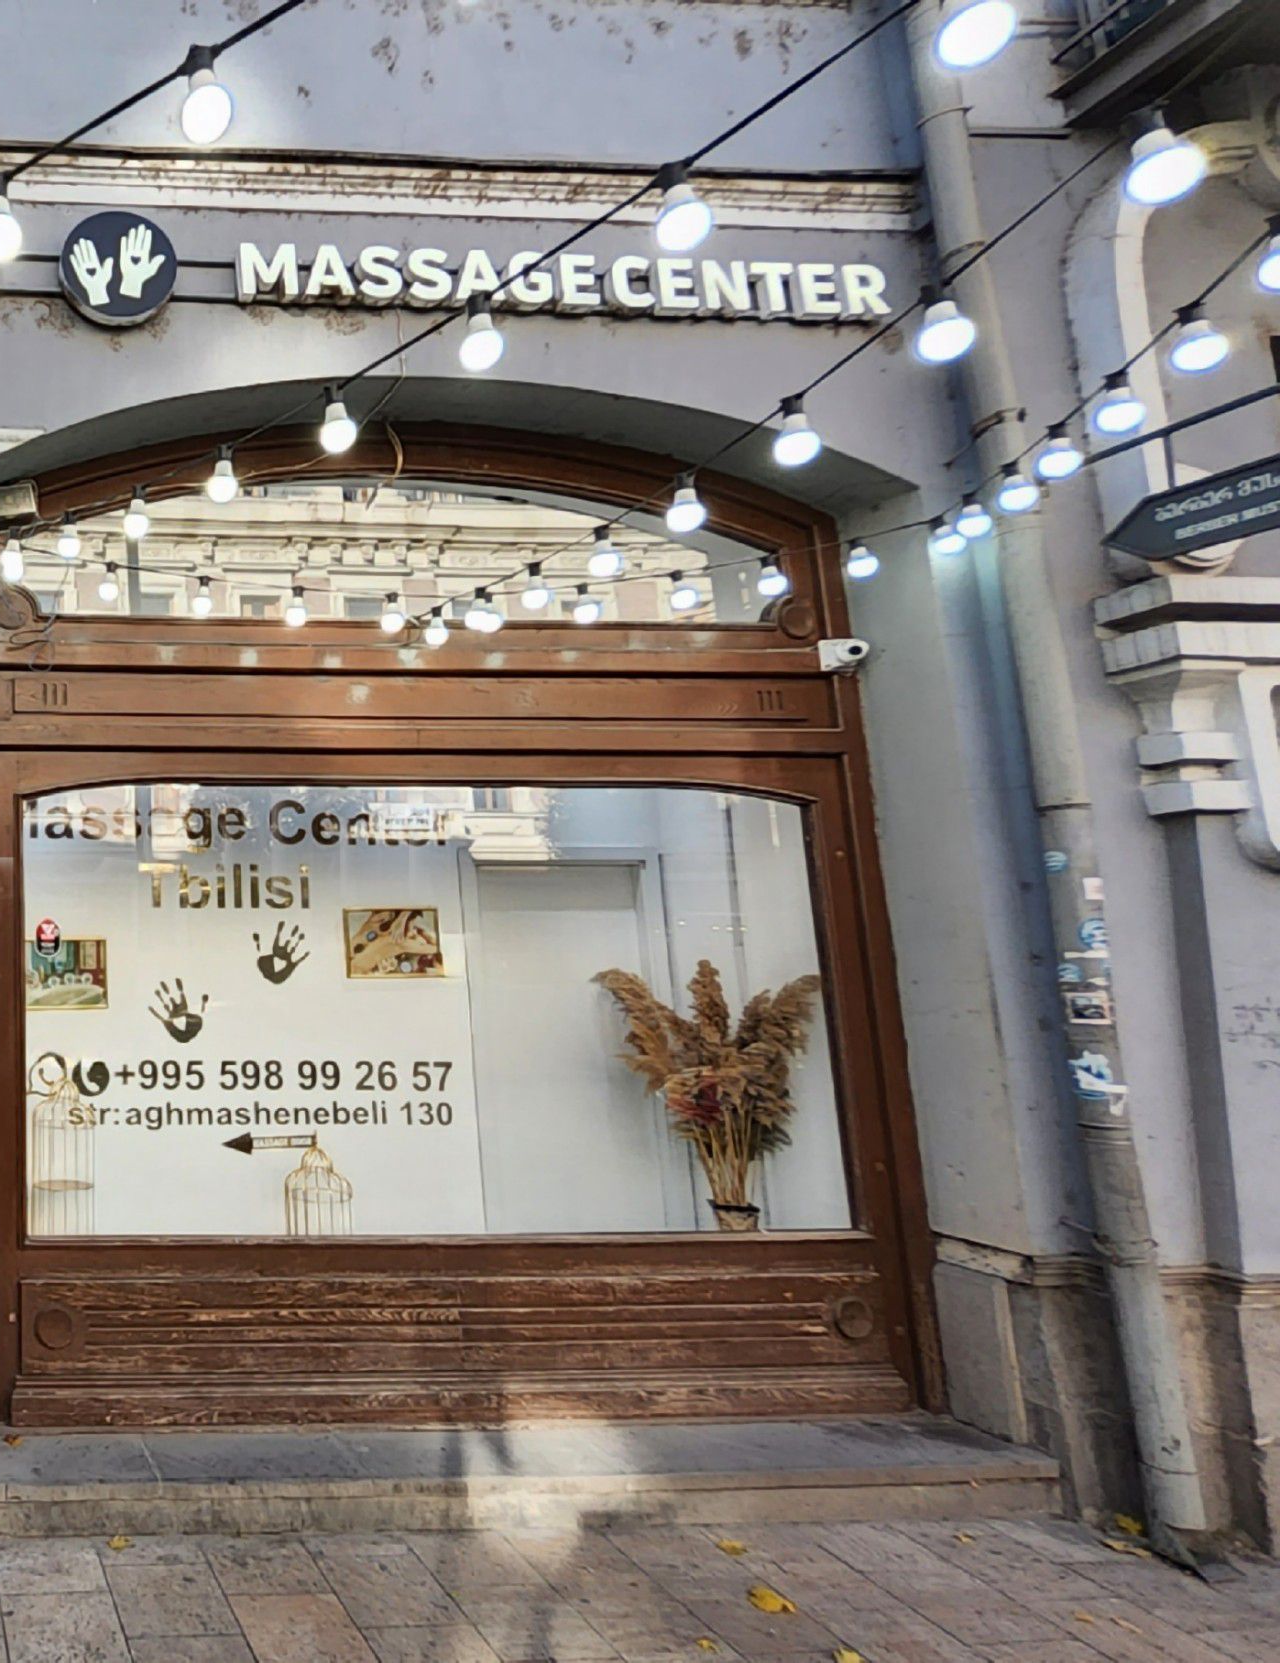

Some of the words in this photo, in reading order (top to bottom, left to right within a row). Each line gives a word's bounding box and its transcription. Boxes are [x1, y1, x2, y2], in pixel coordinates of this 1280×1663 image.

[138, 862, 311, 909] Tbilisi
[114, 1059, 205, 1091] +995
[219, 1059, 284, 1091] 598
[298, 1059, 341, 1091] 99
[354, 1060, 398, 1092] 26
[411, 1060, 454, 1093] 57
[399, 1102, 453, 1127] 130
